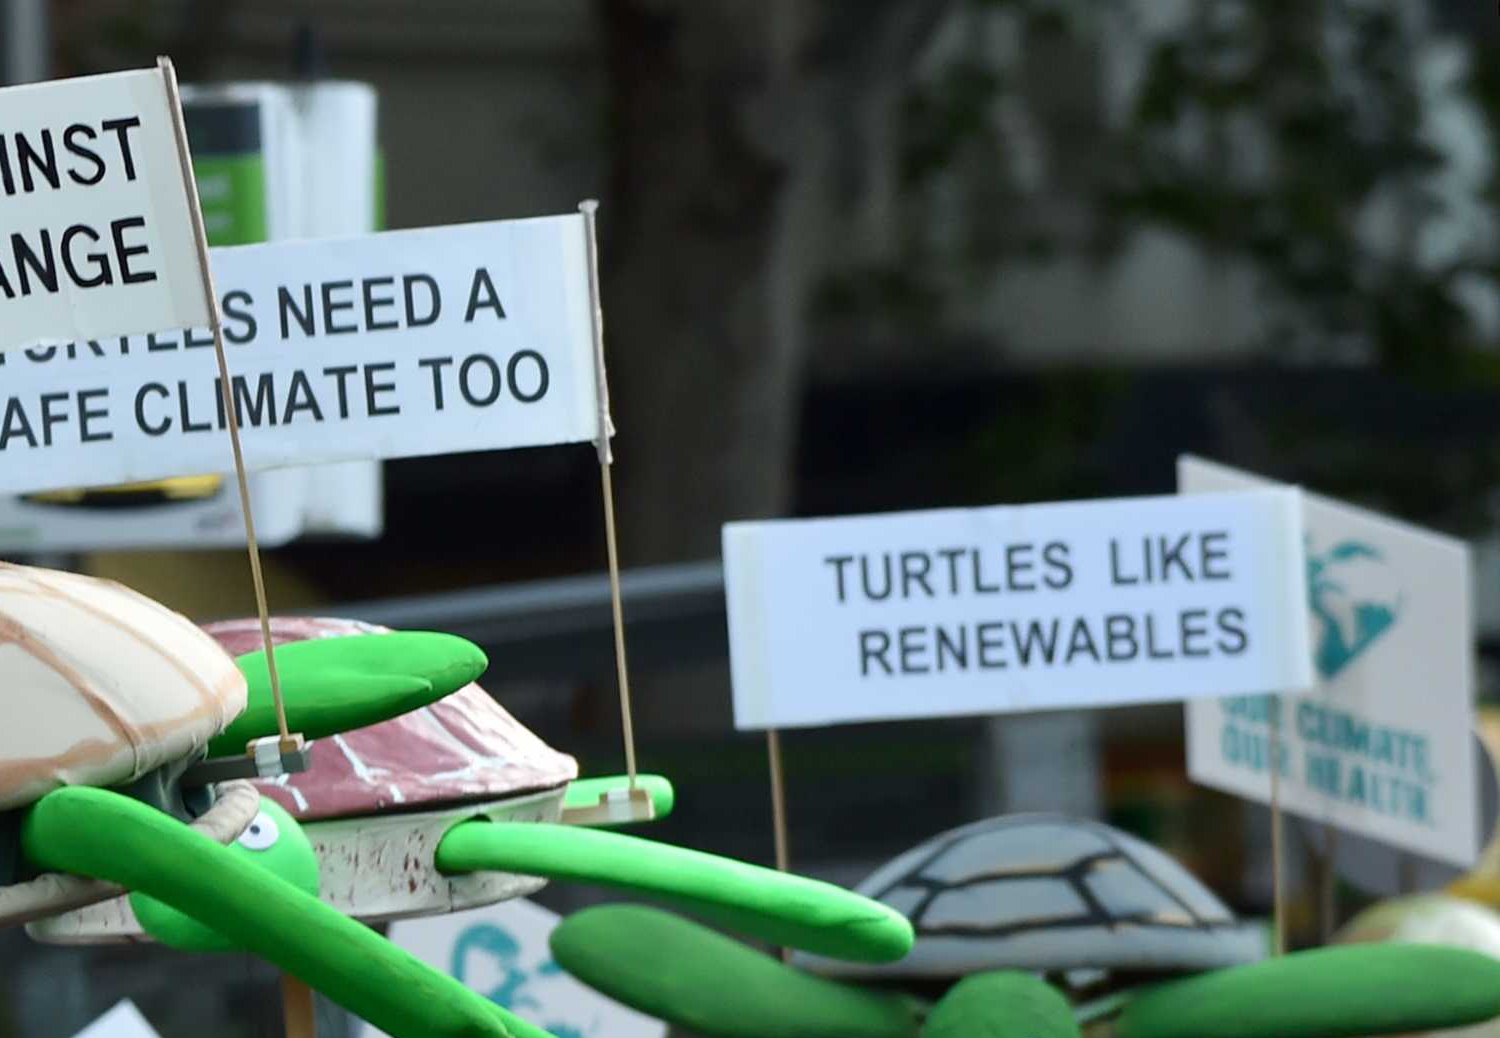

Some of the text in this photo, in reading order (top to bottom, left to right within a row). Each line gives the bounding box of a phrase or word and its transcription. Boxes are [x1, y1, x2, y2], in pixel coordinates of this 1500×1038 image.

[277, 273, 442, 340] NEED
[464, 267, 507, 323] A
[133, 361, 402, 440] CLIMATE
[418, 349, 550, 411] TOO
[824, 531, 1232, 604] TURTLES LIKE
[858, 606, 1250, 678] RENEWABLES
